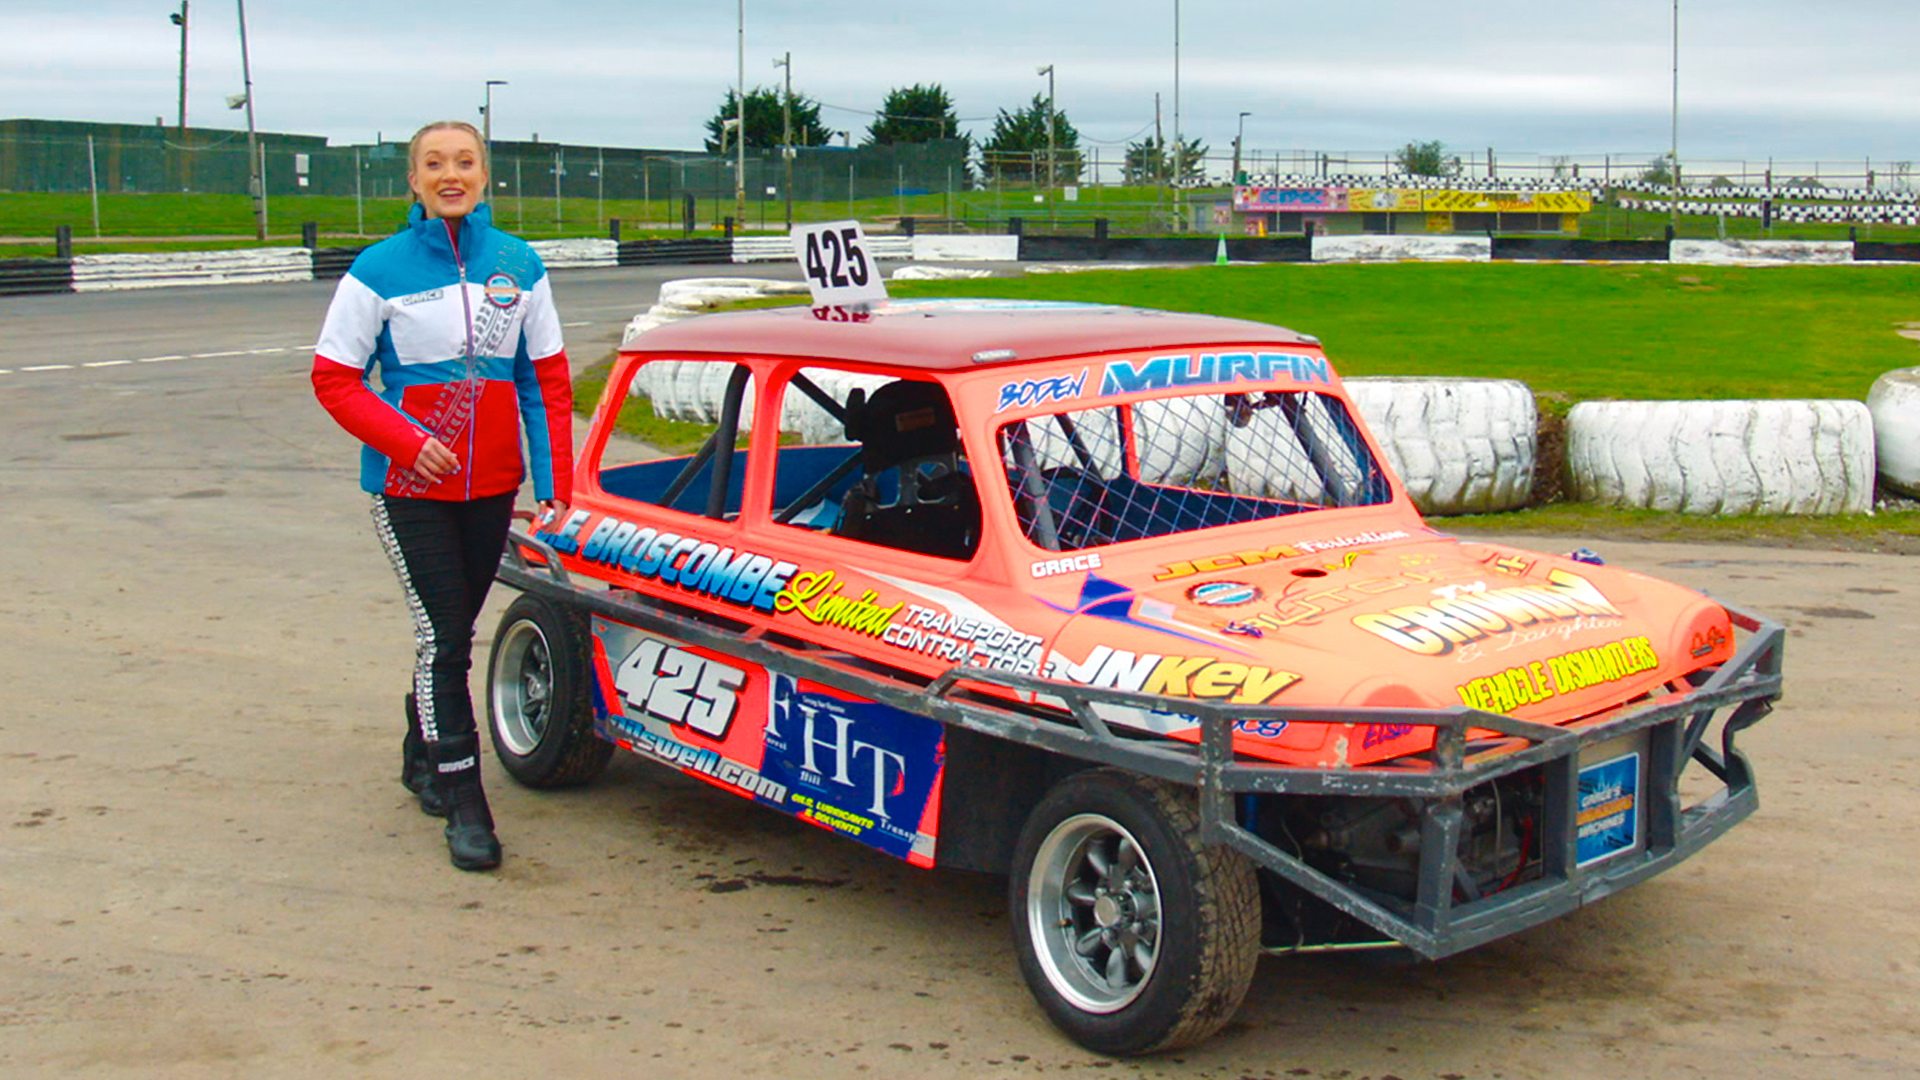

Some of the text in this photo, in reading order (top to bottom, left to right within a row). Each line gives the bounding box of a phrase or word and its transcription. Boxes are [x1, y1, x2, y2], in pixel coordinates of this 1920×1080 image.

[806, 227, 868, 288] 425
[998, 351, 1330, 413] BODEN MURFIN
[582, 516, 799, 612] BROSCOMBE
[774, 570, 905, 637] Limited
[1031, 553, 1102, 578] GRACE
[1153, 544, 1303, 582] JCM
[903, 604, 1044, 658] TRANSPORT
[1352, 569, 1622, 656] CROWDY
[1496, 614, 1624, 652] Daughter
[614, 636, 748, 743] 425
[1456, 635, 1660, 715] VEHICLE DISMANTLERS
